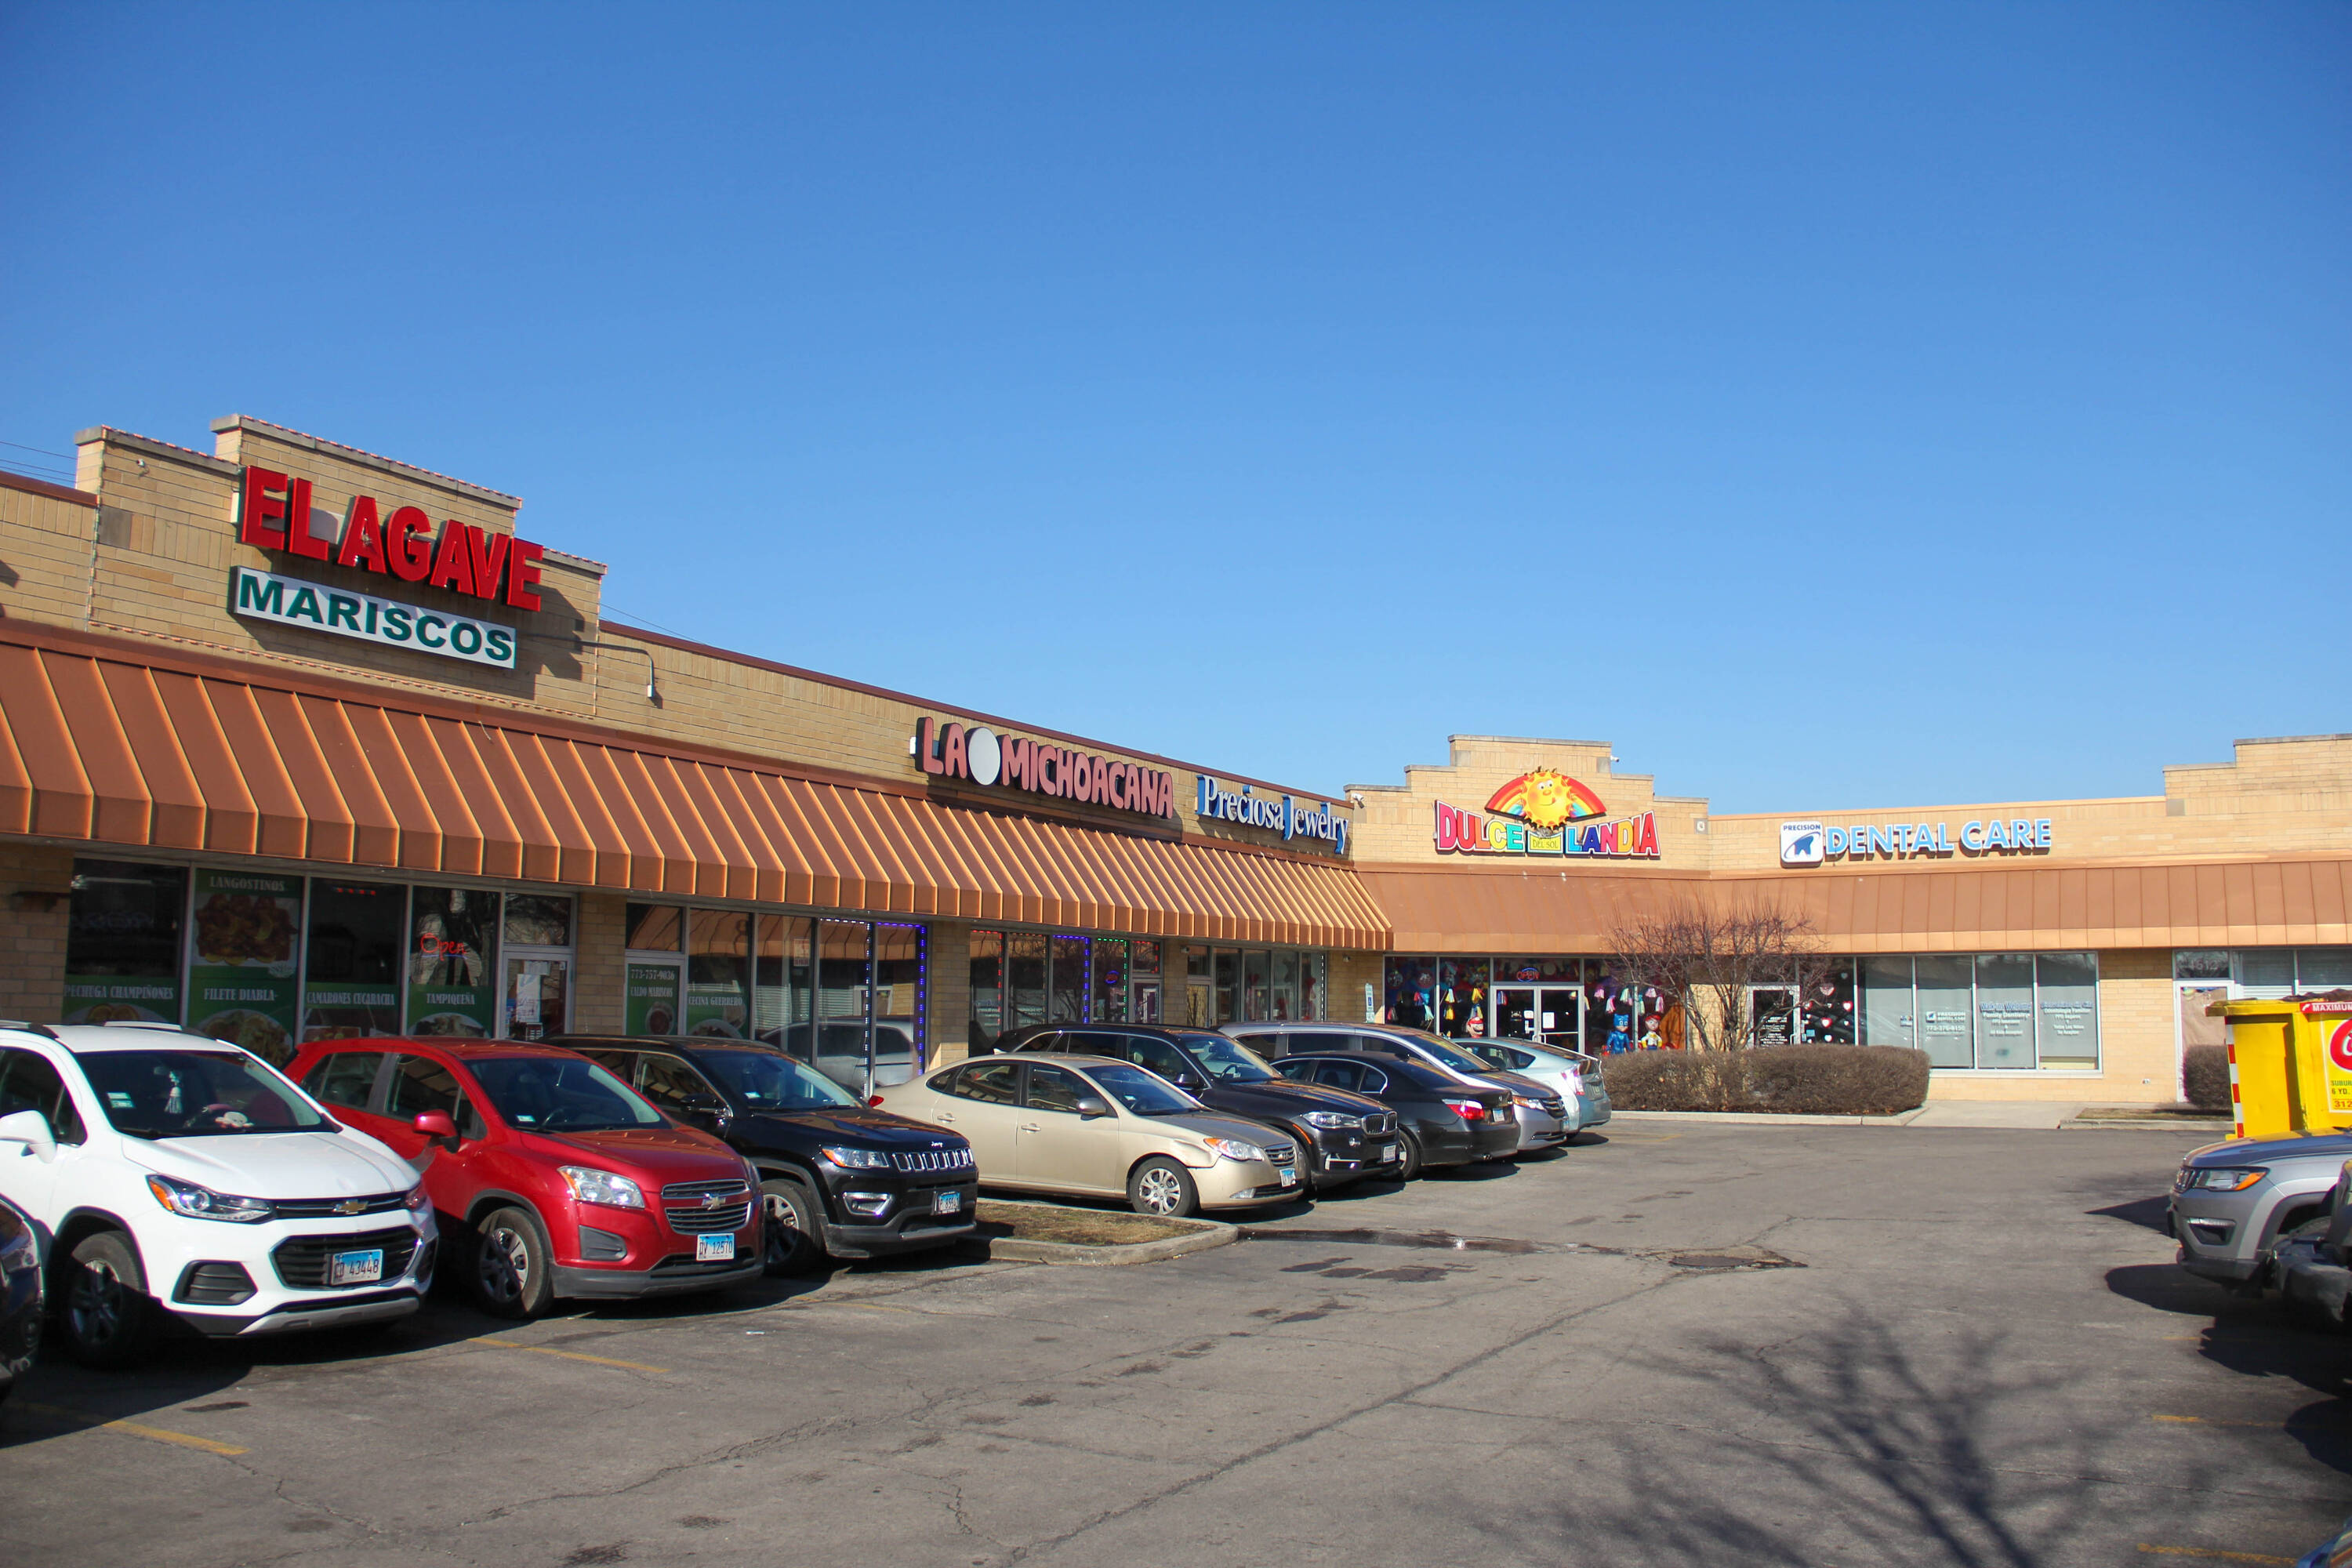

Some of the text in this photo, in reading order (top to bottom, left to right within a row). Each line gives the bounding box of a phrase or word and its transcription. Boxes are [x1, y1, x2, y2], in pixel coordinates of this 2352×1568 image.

[239, 466, 544, 612] EL AGAVE
[239, 573, 513, 661] MARISCOS
[918, 717, 1174, 819] LA MICHOACANA
[1199, 775, 1349, 855] Preciosa Jewelry
[1436, 800, 1661, 855] DULCE LANDIA
[1533, 839, 1544, 848] DEL
[1825, 818, 2051, 855] DENTAL CARE
[209, 876, 285, 891] LANGOSTINOS
[420, 933, 467, 961] Open
[64, 984, 174, 1000] PECHUGA CHAMPIÑONES
[204, 988, 237, 1000] FILETE
[307, 992, 351, 1004] CAMARONES
[426, 992, 475, 1005] TAMPIQUEÑA
[710, 996, 742, 1006] GUERRERO
[712, 1240, 733, 1254] 12570
[349, 1258, 379, 1276] 43448
